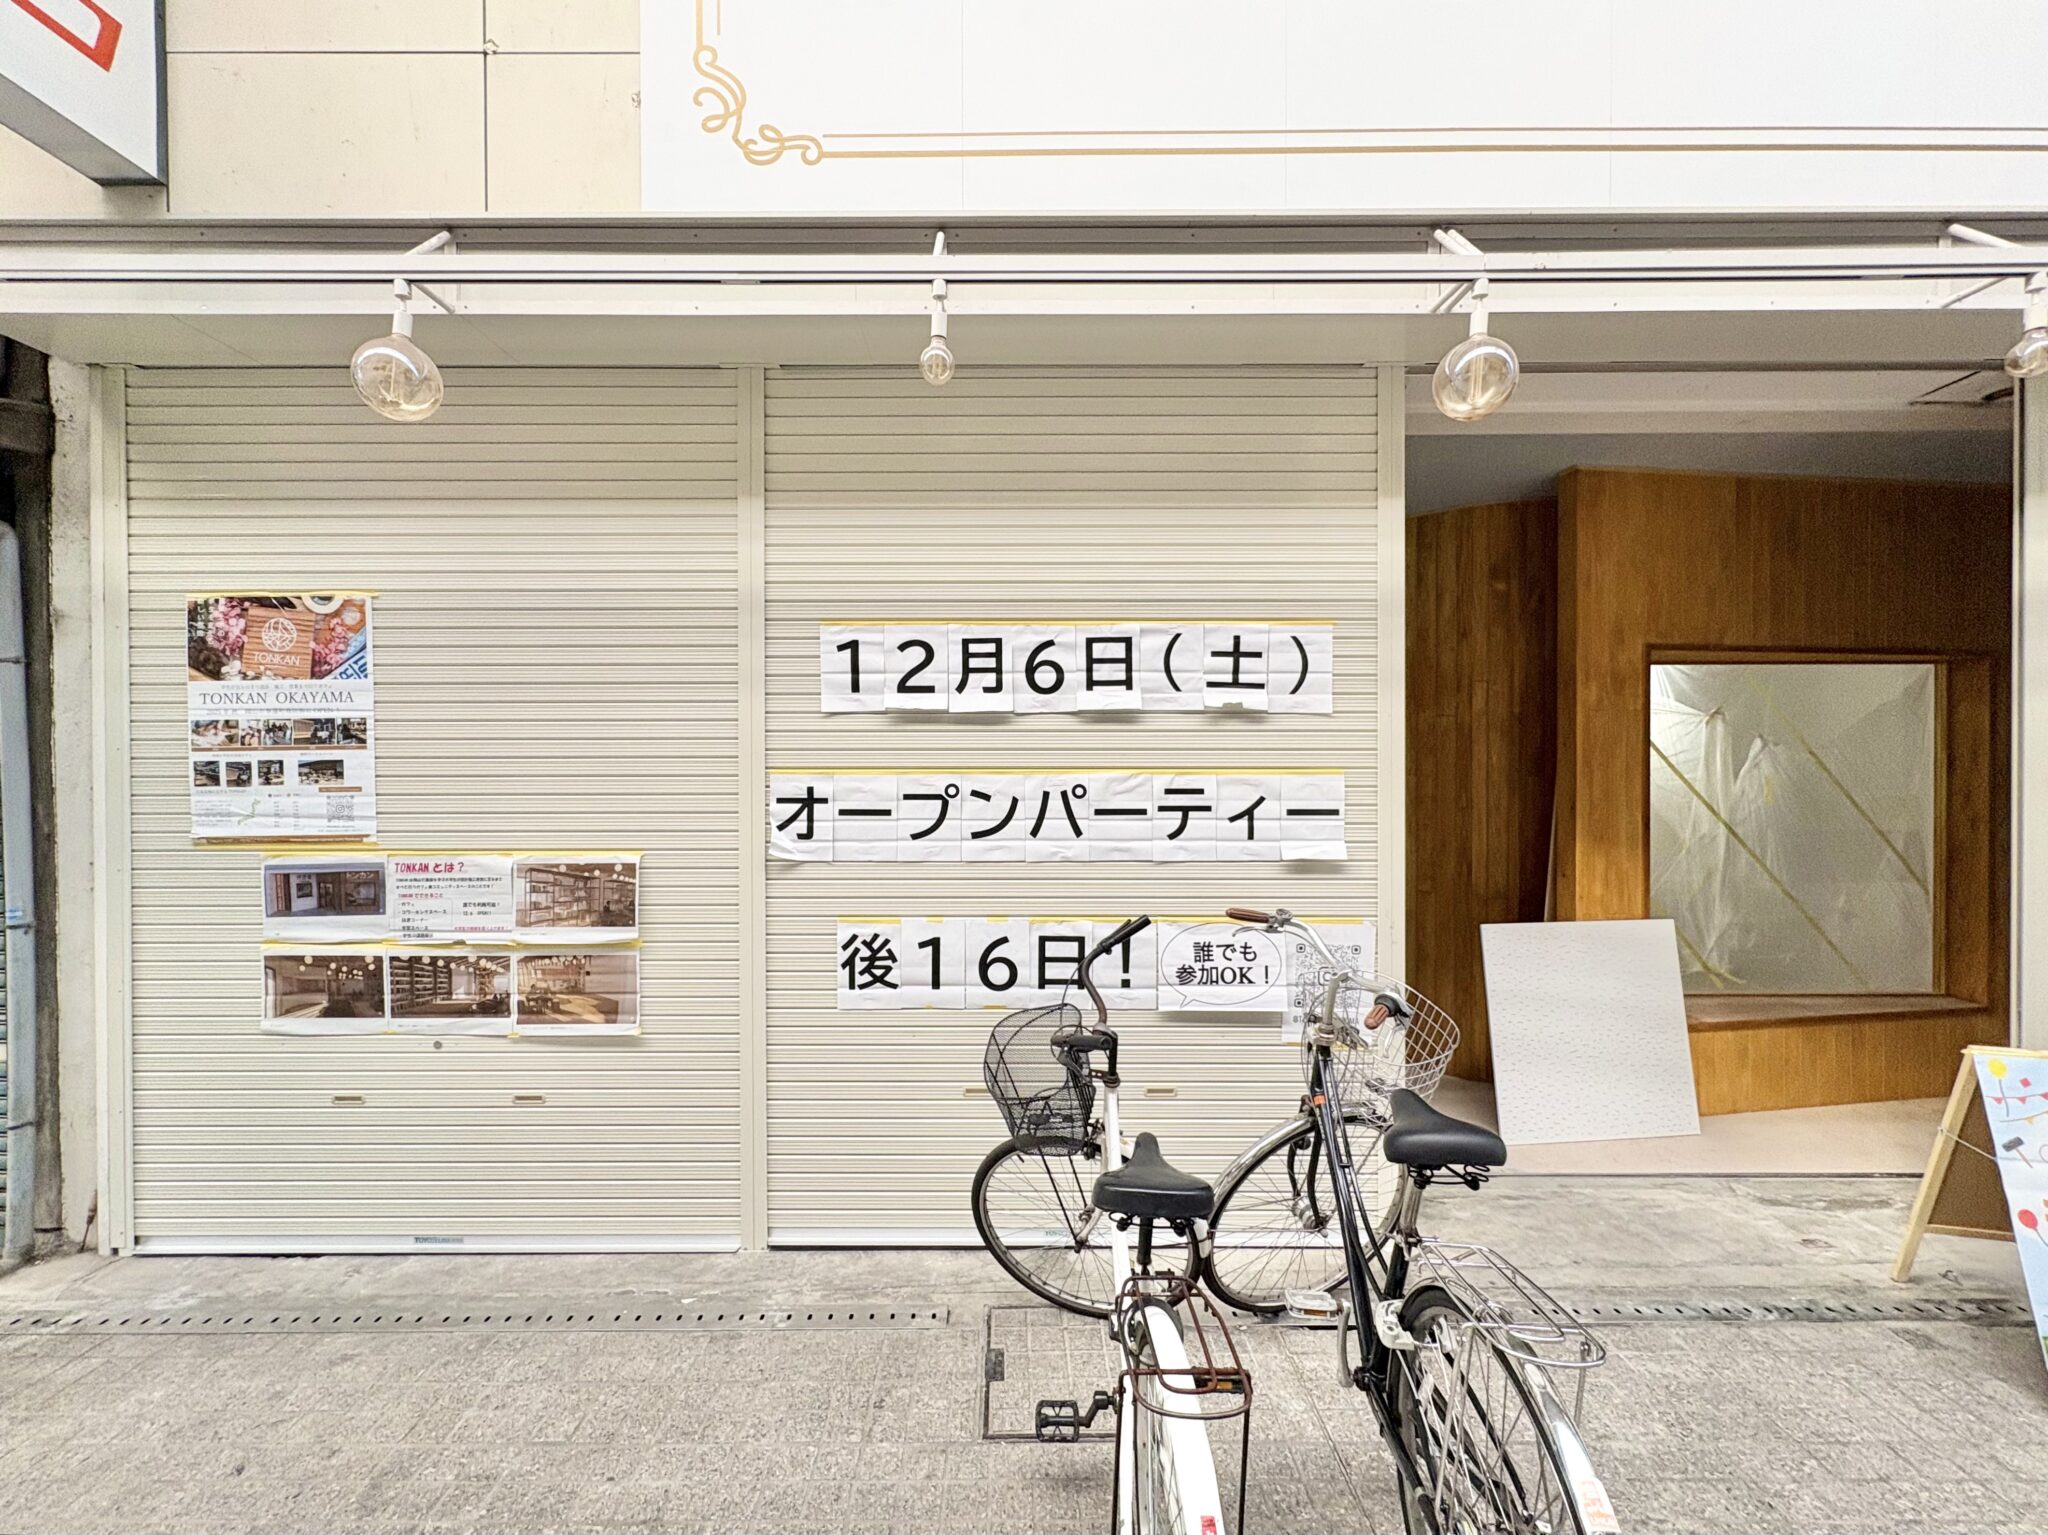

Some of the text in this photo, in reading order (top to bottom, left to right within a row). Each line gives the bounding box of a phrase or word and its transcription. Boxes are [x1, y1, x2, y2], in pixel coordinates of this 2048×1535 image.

[254, 652, 300, 666] TONKAN
[836, 632, 1309, 695] 12月6日（土）
[200, 691, 354, 705] TONKAN OKAYAMA
[776, 783, 1340, 841] オープンパーティー
[394, 862, 429, 873] TONKAN
[1192, 941, 1258, 963] 誰でも
[1175, 964, 1270, 985] 参加OK！
